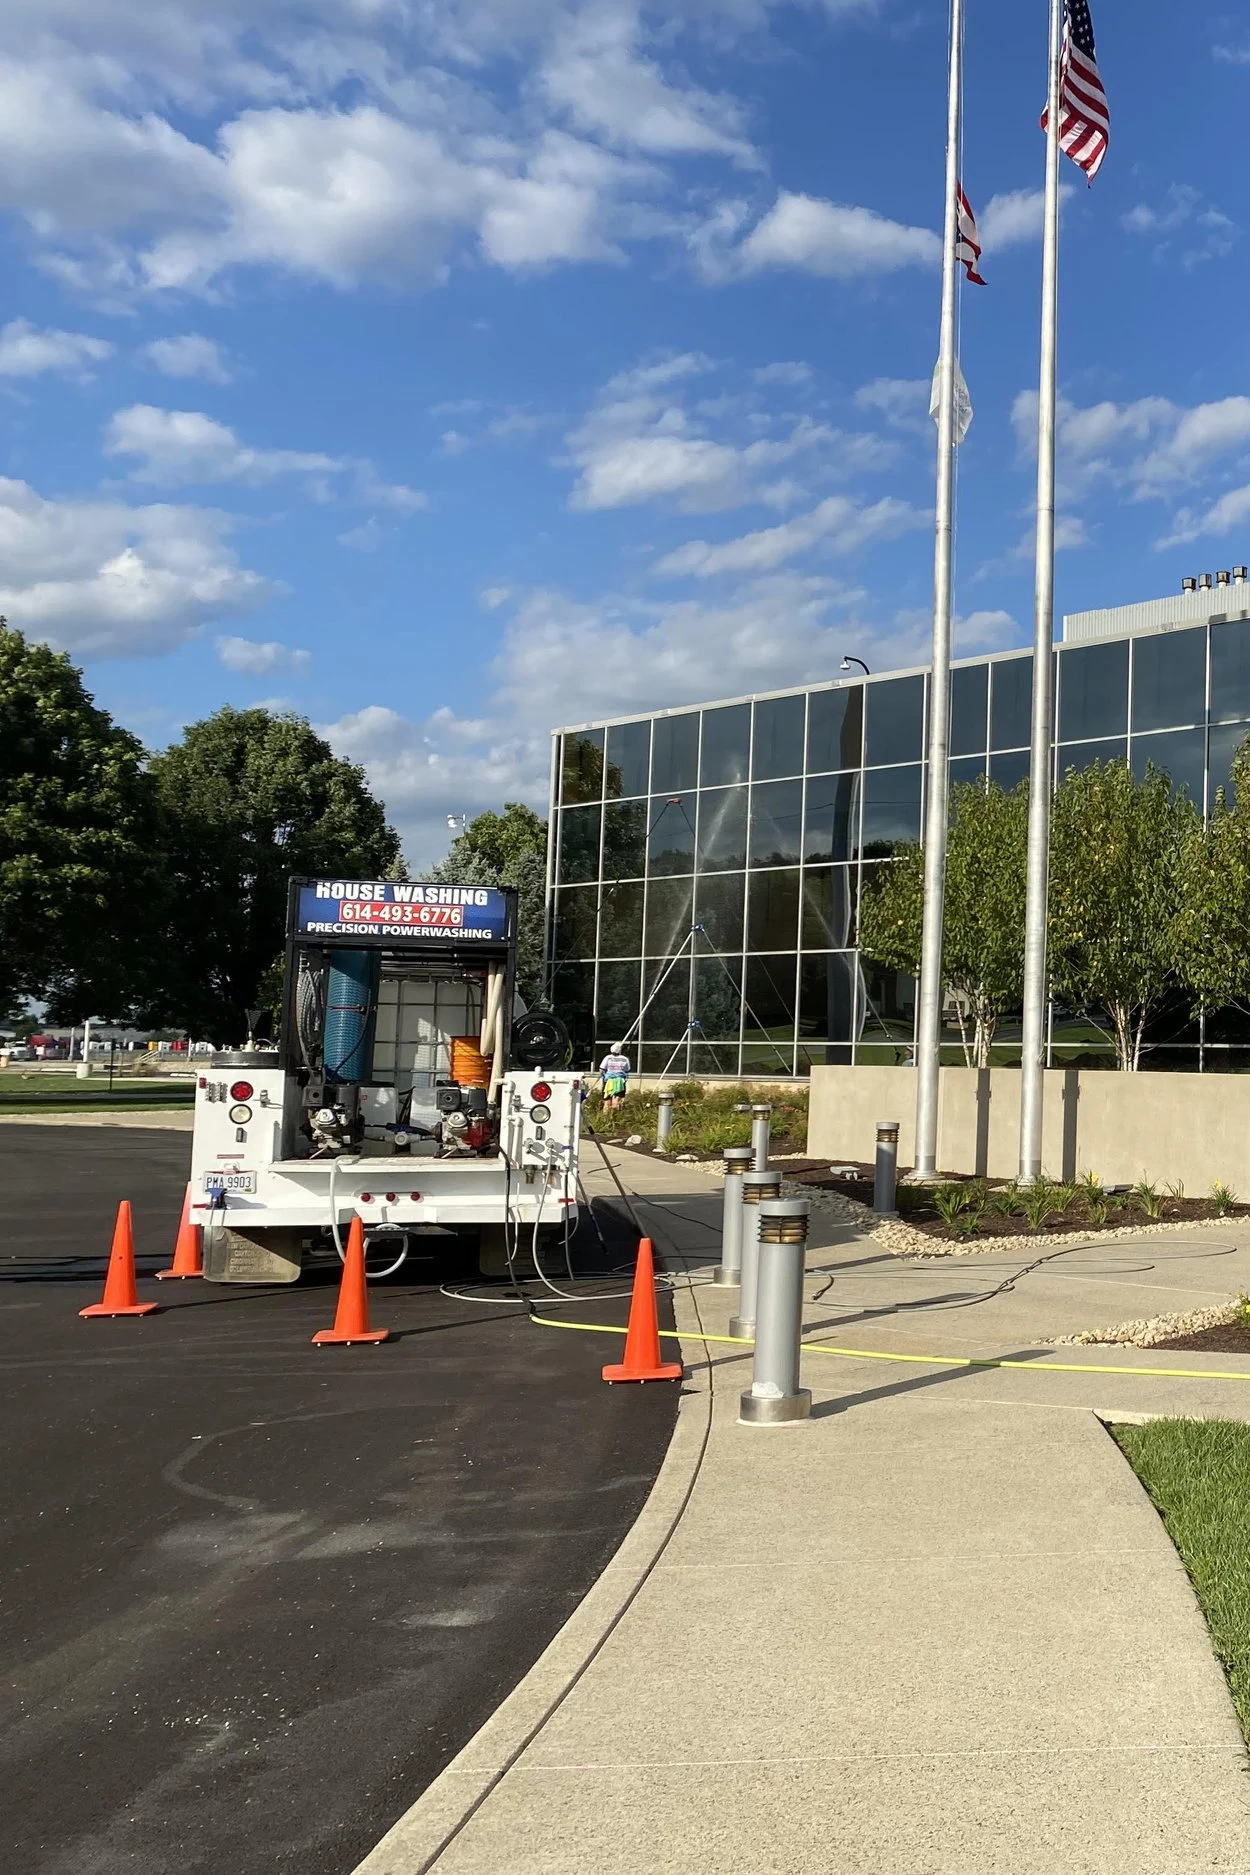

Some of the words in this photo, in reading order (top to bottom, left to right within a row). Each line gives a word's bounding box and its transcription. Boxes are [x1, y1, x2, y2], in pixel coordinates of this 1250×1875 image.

[316, 882, 385, 901] HOUSE
[393, 886, 488, 905] WASHING
[342, 903, 461, 924] 614-493-6776
[307, 922, 379, 935] PRECISION
[382, 925, 492, 939] POWERWASHING
[227, 1176, 252, 1188] 9903
